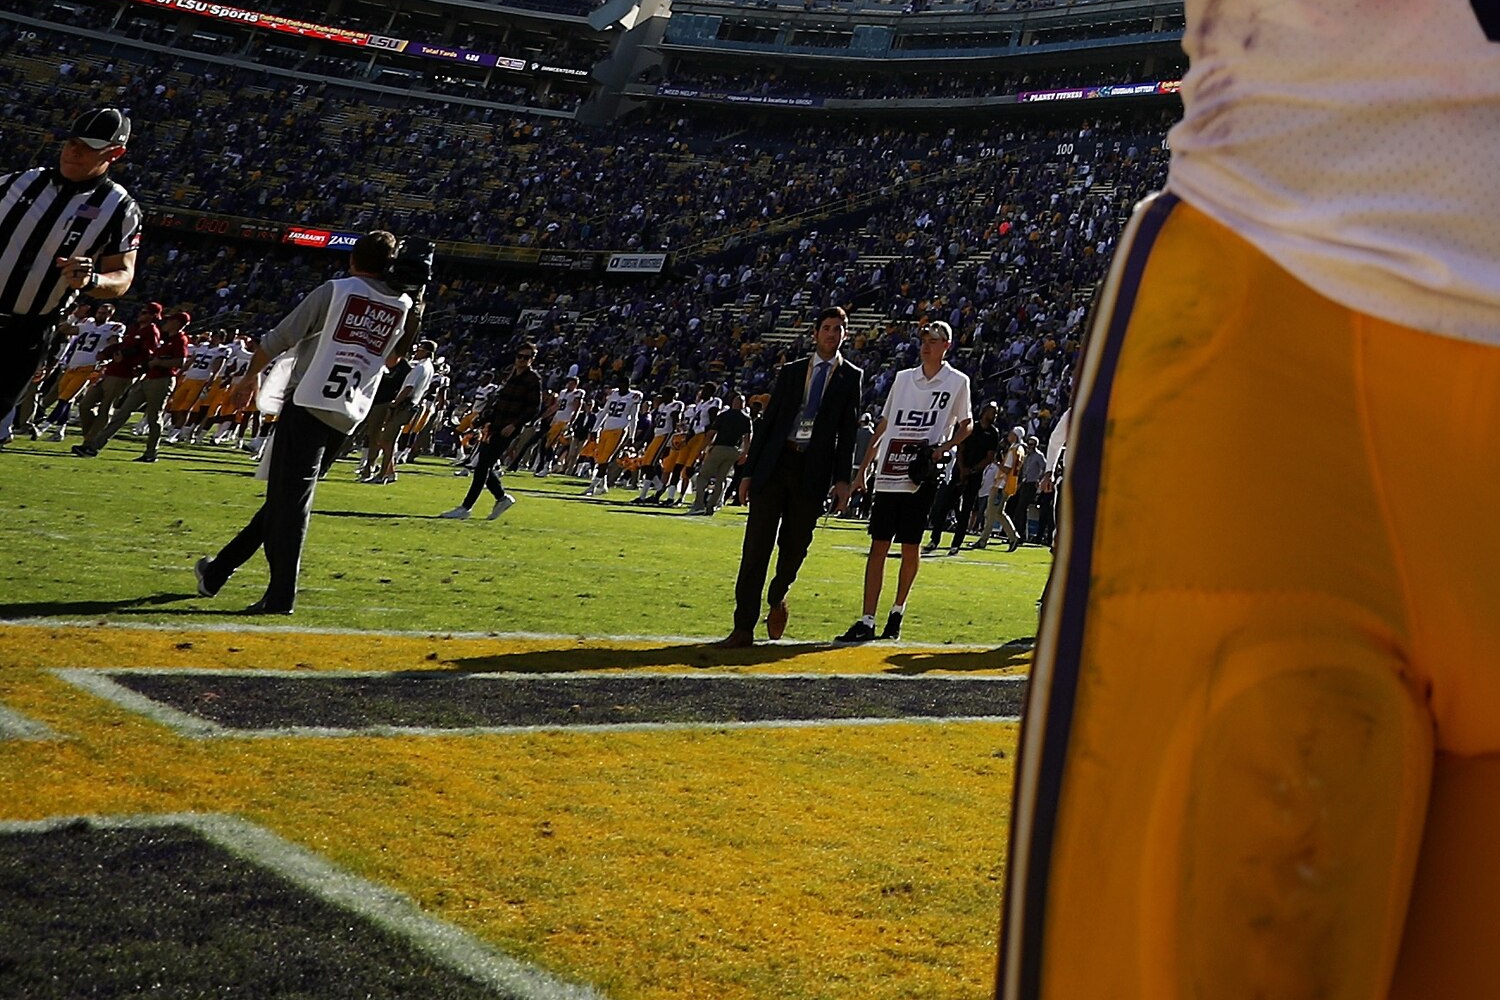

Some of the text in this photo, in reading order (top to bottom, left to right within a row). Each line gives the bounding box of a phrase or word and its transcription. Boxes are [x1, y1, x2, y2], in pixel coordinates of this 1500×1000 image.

[209, 4, 259, 23] Sports
[367, 35, 399, 49] LSU
[1055, 143, 1074, 155] 100
[63, 230, 82, 247] F
[345, 313, 392, 338] BUREAU
[76, 331, 102, 352] 43
[348, 330, 385, 349] INSUNCE
[192, 353, 213, 369] 55
[608, 400, 627, 418] 92
[929, 391, 951, 409] 78
[895, 409, 938, 427] LSU
[888, 452, 918, 462] BUREA
